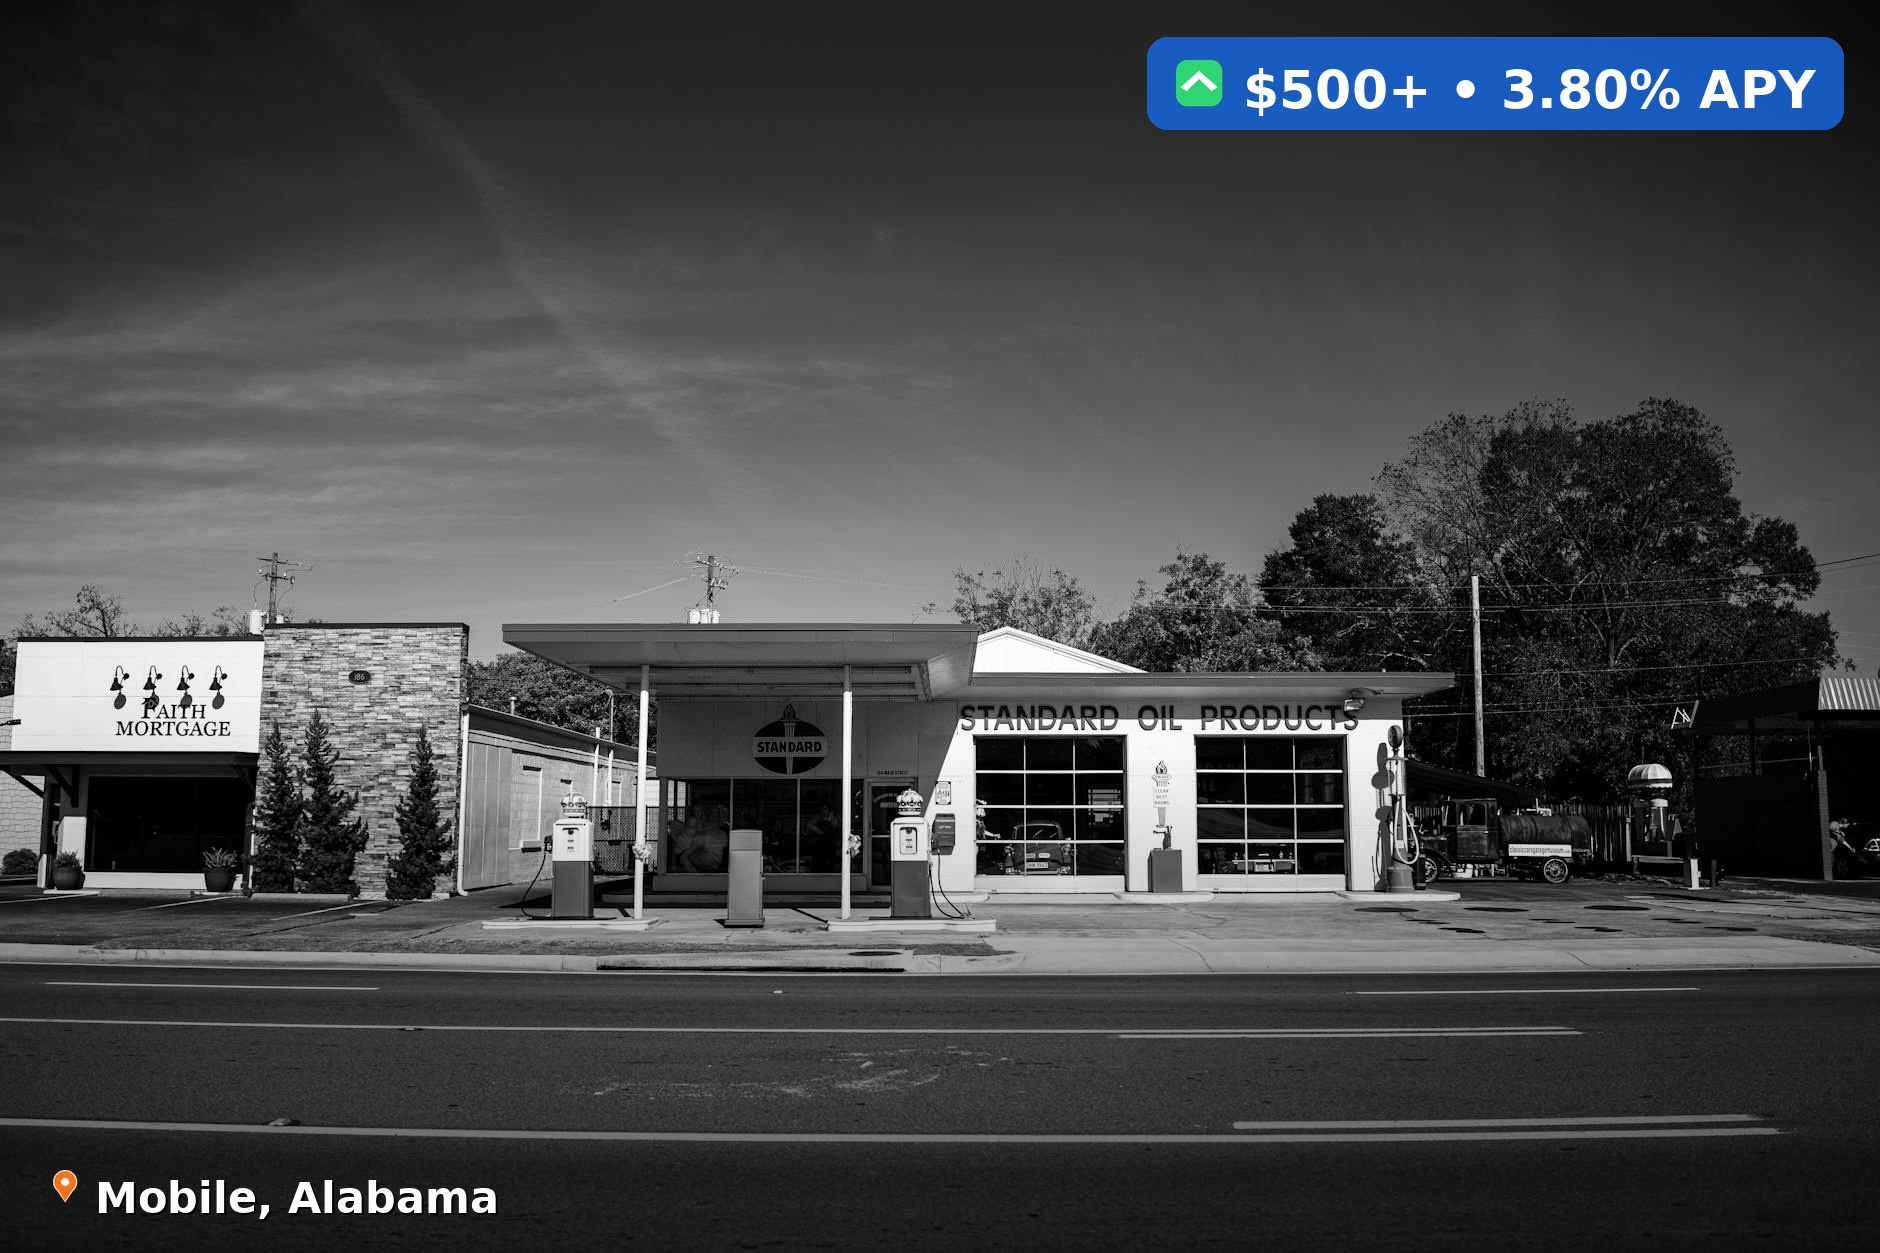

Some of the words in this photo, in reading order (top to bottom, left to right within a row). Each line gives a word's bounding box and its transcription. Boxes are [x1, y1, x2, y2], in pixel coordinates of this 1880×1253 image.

[961, 704, 1119, 732] STANDARD
[1138, 704, 1183, 732] OIL
[1200, 704, 1359, 732] PRODUCTS
[115, 720, 231, 737] MORTGAGE
[757, 741, 822, 753] STANDARD
